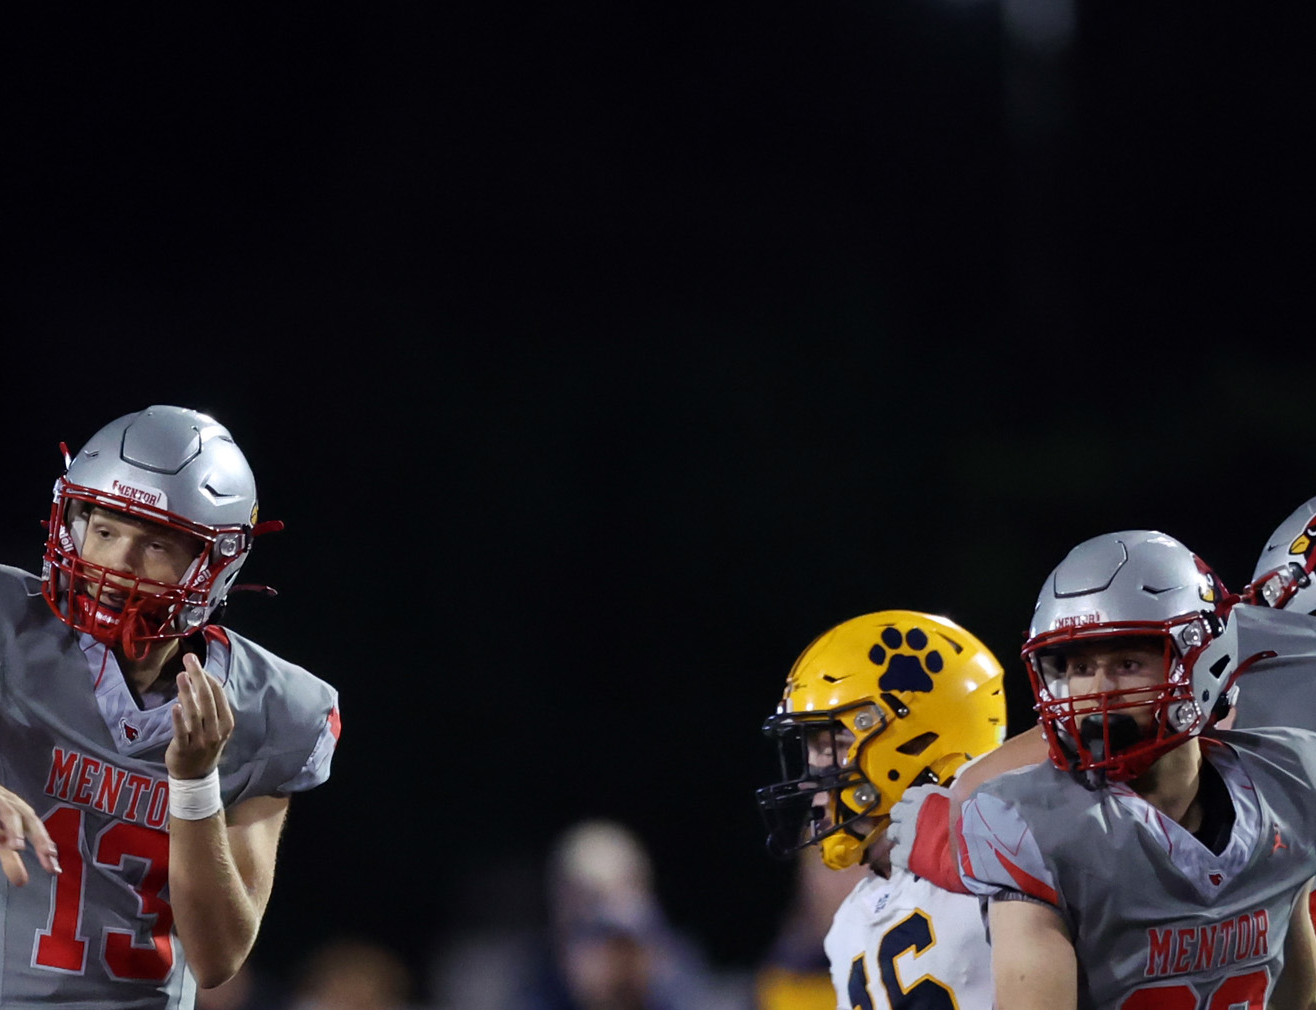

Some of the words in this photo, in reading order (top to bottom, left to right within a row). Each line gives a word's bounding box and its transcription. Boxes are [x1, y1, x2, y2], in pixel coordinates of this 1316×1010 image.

[44, 745, 170, 831] MENTO
[30, 802, 177, 983] 13
[1143, 908, 1271, 977] MENTOR
